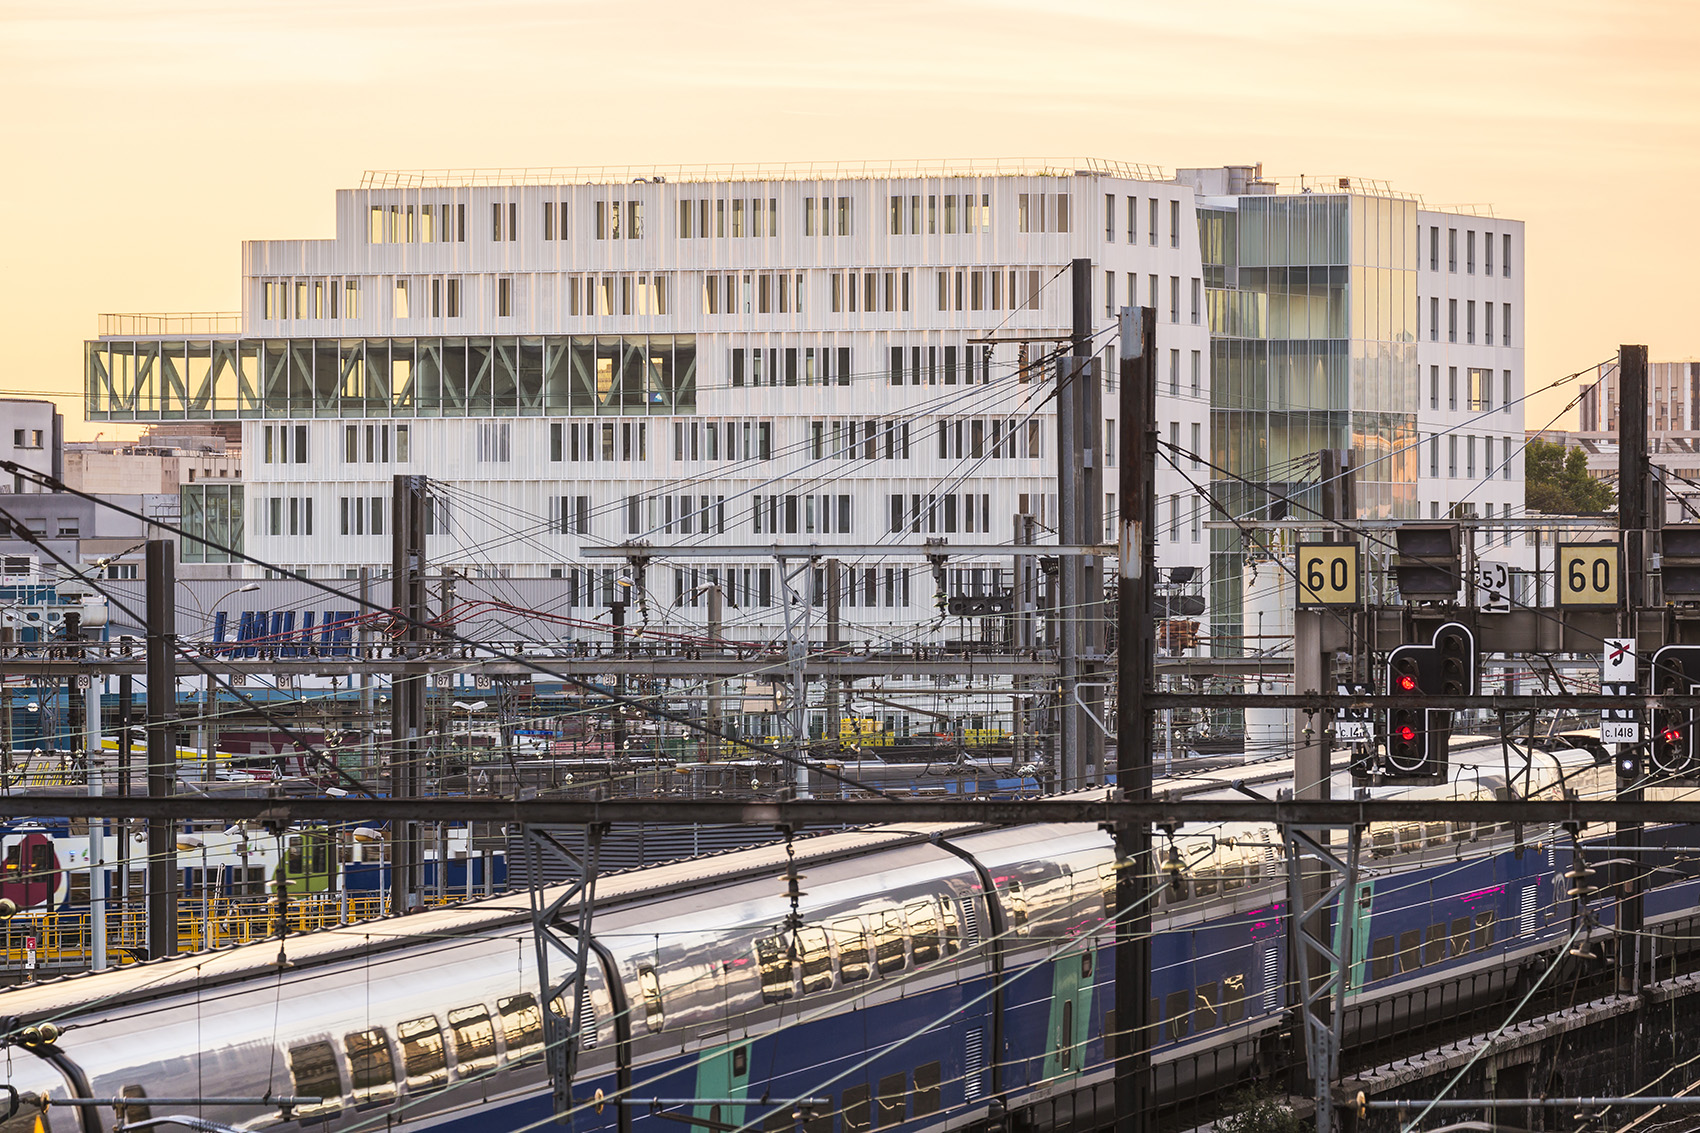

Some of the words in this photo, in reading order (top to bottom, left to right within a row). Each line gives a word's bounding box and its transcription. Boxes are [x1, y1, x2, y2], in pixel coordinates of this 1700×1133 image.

[1308, 557, 1348, 592] 60
[1482, 571, 1494, 589] 5
[1568, 558, 1610, 593] 60
[78, 676, 89, 687] 89
[233, 674, 244, 685] 85
[279, 676, 290, 687] 91
[437, 676, 449, 686] 87
[477, 676, 490, 688] 93
[1605, 727, 1634, 738] c.1418
